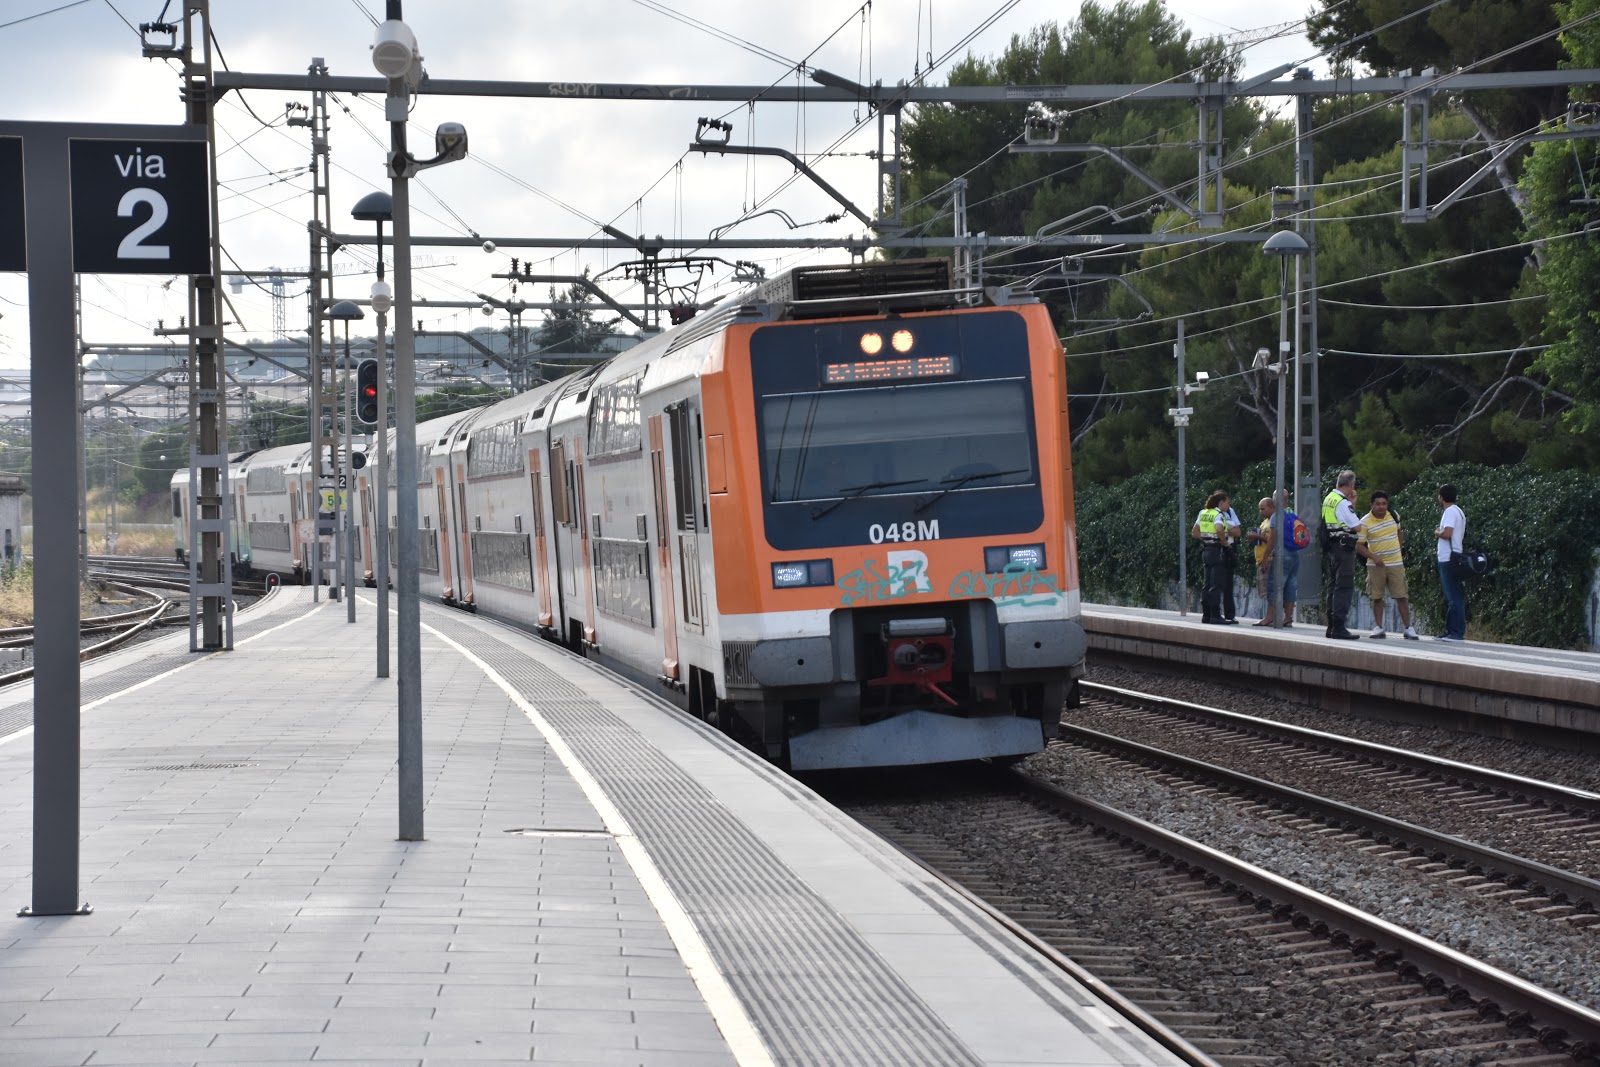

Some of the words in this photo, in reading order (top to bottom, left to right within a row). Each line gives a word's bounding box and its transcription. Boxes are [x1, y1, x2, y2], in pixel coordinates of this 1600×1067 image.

[114, 147, 166, 178] via
[117, 187, 170, 259] 2
[869, 519, 940, 544] 048M
[887, 551, 930, 595] R
